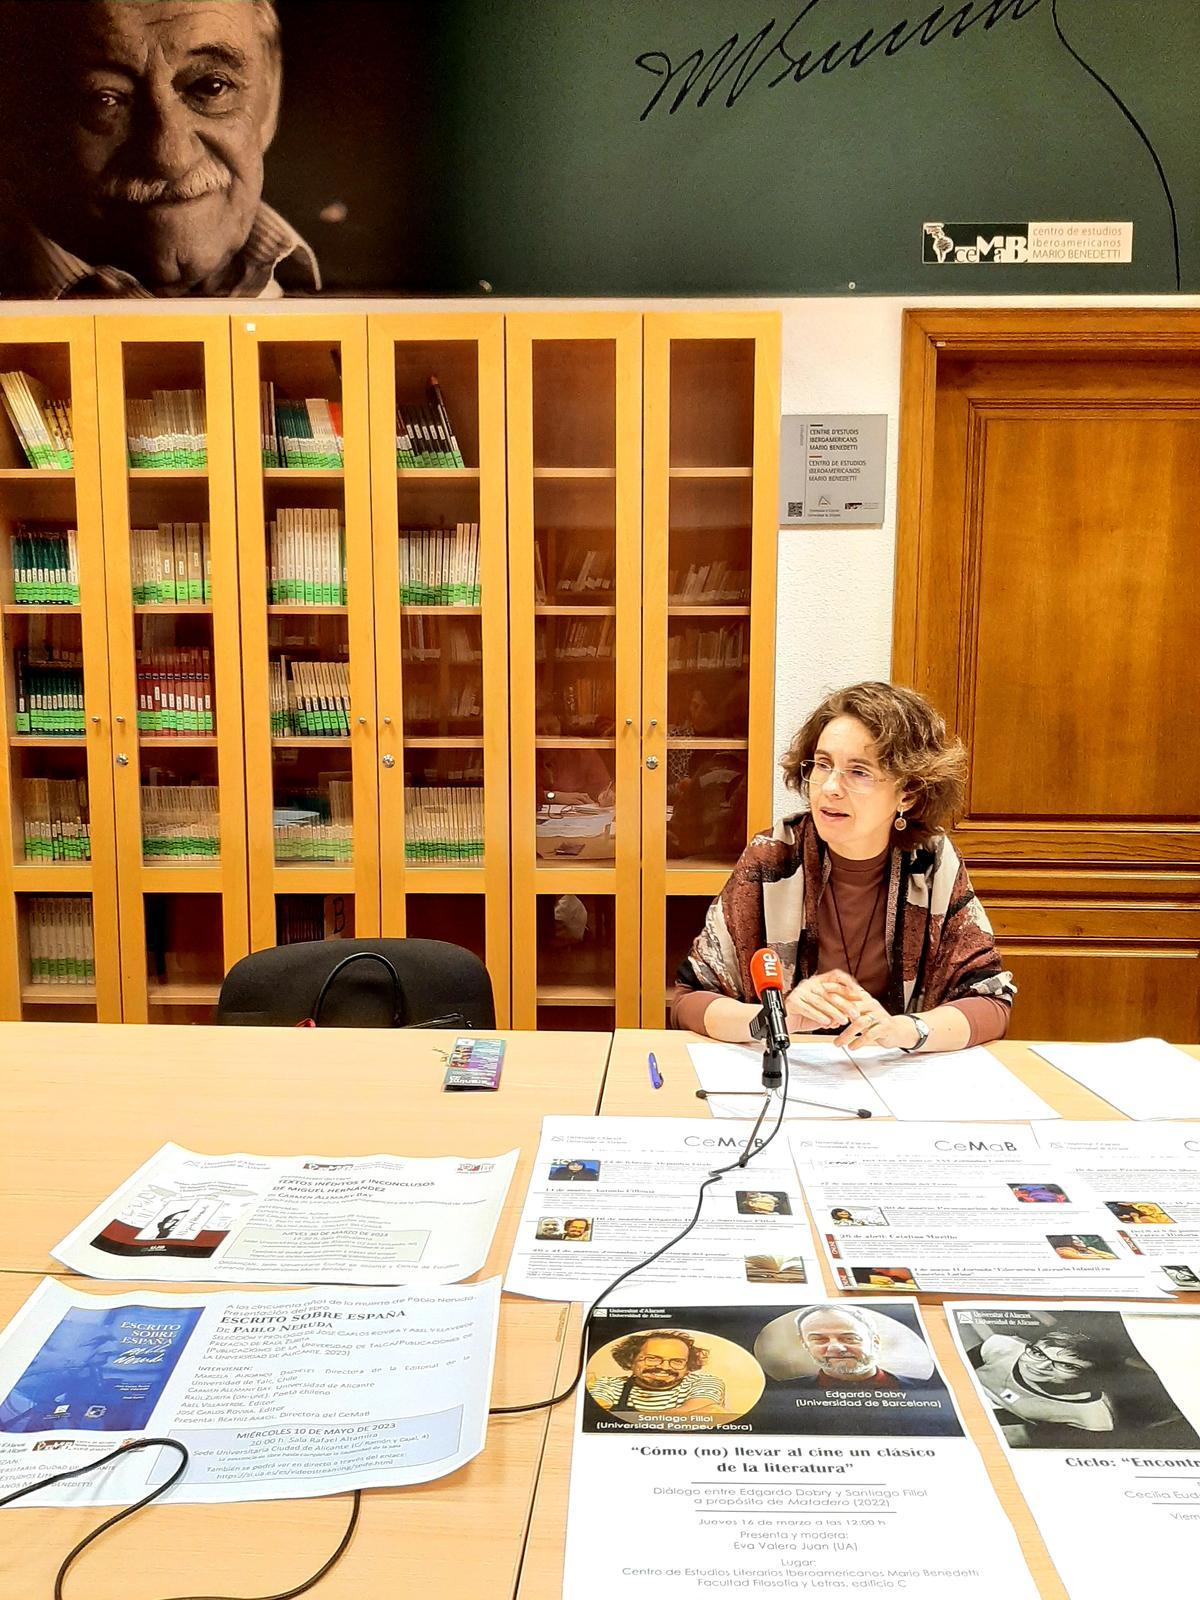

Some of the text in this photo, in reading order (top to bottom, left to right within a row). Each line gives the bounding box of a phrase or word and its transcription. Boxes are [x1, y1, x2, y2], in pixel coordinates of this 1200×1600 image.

[1032, 227, 1122, 237] centro de estudios
[1032, 238, 1121, 248] iberoamericanos
[1032, 249, 1121, 259] MARIO BENEDETTI
[934, 1140, 1018, 1152] CeMaB
[220, 1309, 406, 1325] ESCRITO SOBRE ESPAÑA
[120, 1321, 181, 1331] ESCRITO
[825, 1390, 872, 1399] Edgardo
[795, 1399, 942, 1409] (Universidad de Barcelona)
[637, 1414, 688, 1423] Santiago
[236, 1422, 397, 1440] MIÉRCOLES 10 DE MAYO DE 2023
[596, 1422, 753, 1432] (Universidad Pompeu Fabra)
[192, 1449, 214, 1457] Sede
[216, 1446, 269, 1456] Universitaria
[271, 1444, 301, 1452] Ciudad
[694, 1446, 729, 1459] (no)
[734, 1446, 783, 1457] llevar
[787, 1447, 803, 1457] al
[808, 1447, 844, 1458] cine
[849, 1449, 872, 1458] un
[877, 1447, 936, 1458] clásico
[716, 1462, 737, 1473] de
[742, 1462, 760, 1473] la
[1064, 1457, 1117, 1467] Ciclo:
[652, 1486, 701, 1497] Diálogo
[704, 1487, 737, 1496] entre
[739, 1487, 793, 1499] Edgardo
[795, 1488, 833, 1499] Dobry
[834, 1490, 843, 1499] y
[844, 1488, 900, 1499] Santiago
[1123, 1490, 1172, 1499] Cecilia
[705, 1497, 764, 1507] propósito
[766, 1497, 784, 1506] de
[787, 1498, 851, 1506] Matadero
[853, 1498, 890, 1508] (2022)
[698, 1518, 738, 1526] Jueves
[757, 1518, 774, 1527] de
[775, 1519, 812, 1527] marzo
[814, 1519, 824, 1527] a
[825, 1518, 843, 1527] las
[845, 1518, 875, 1527] 12:00
[740, 1530, 849, 1541] Presenta y modera:
[733, 1541, 756, 1551] Eva
[800, 1541, 830, 1551] Juan
[833, 1541, 858, 1552] (UA)
[621, 1566, 981, 1579] Centro de Estudios Literarios Iberoamericanos Mario Benedetti
[696, 1577, 750, 1588] Facultad
[800, 1580, 809, 1590] y
[851, 1578, 895, 1588] edificio
[896, 1579, 907, 1588] C
